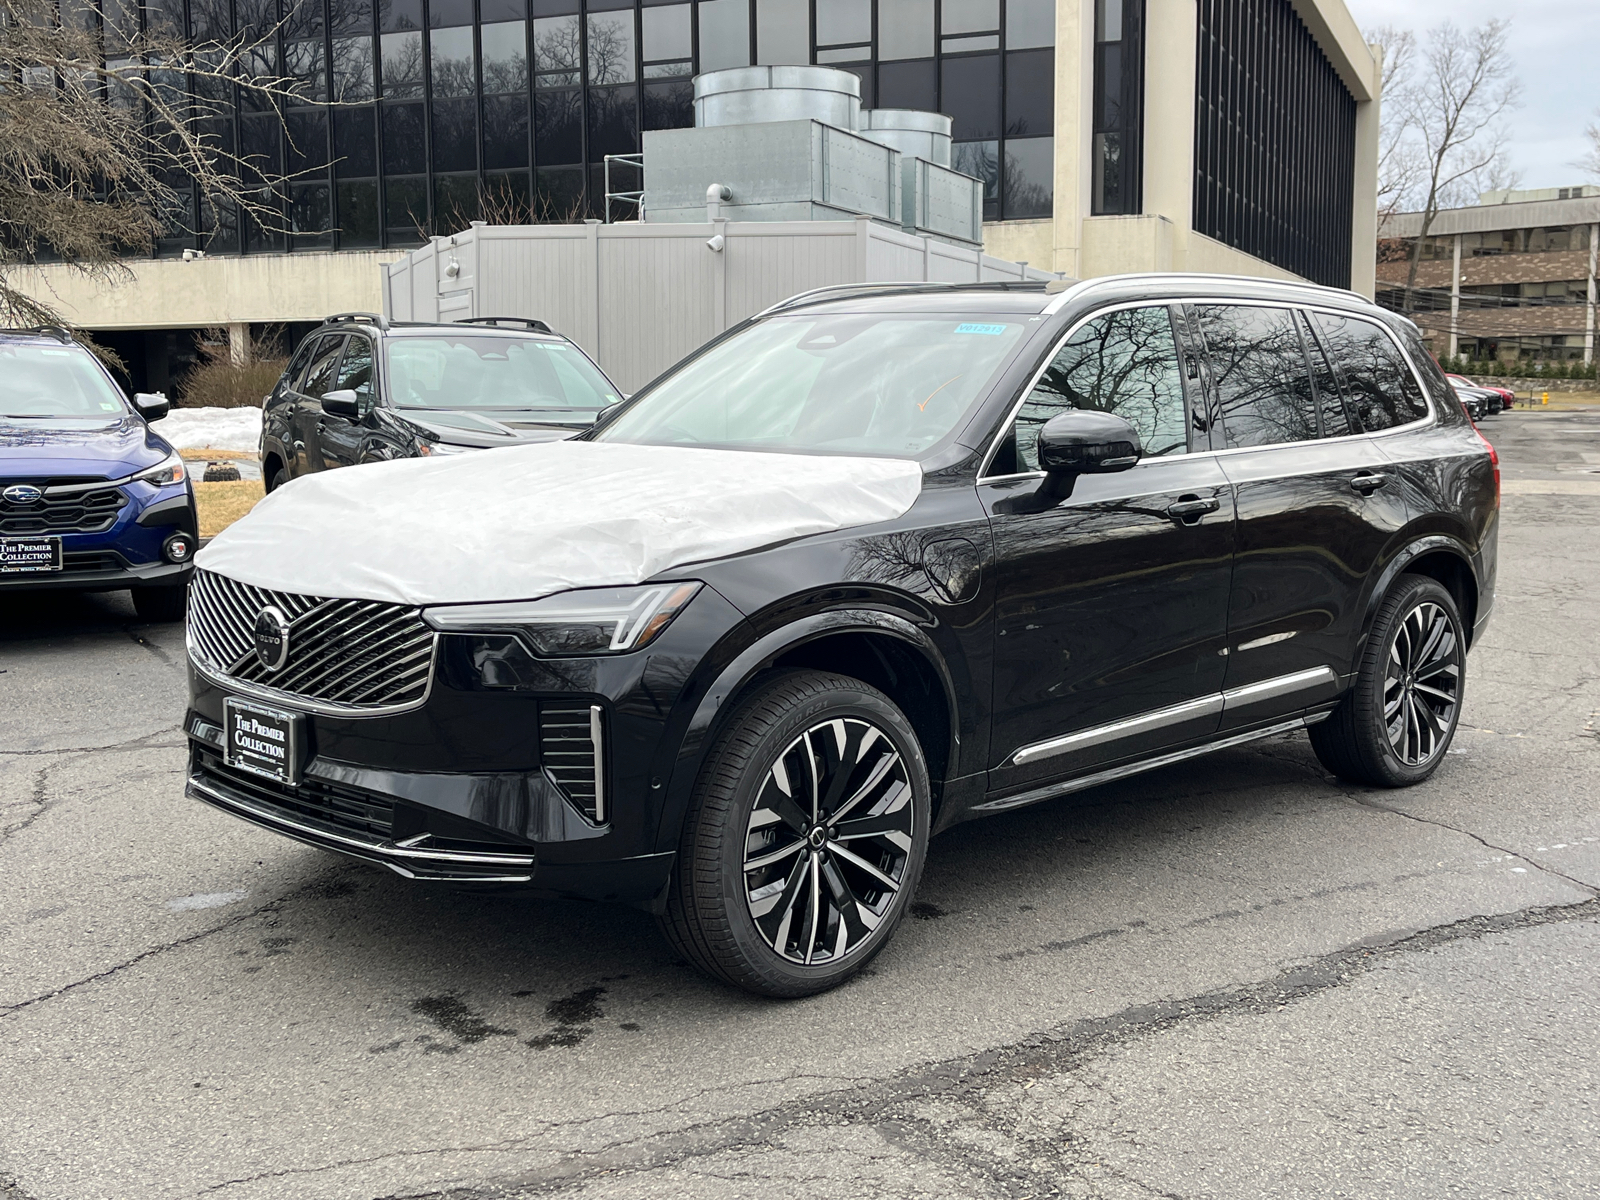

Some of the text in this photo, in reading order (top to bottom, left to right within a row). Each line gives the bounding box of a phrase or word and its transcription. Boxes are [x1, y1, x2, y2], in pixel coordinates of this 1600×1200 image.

[0, 543, 52, 553] THE PREMIER
[0, 552, 52, 561] COLLECTION
[256, 633, 281, 645] VOLVO
[235, 714, 285, 742] THE PREMIER
[235, 730, 285, 759] COLLECTION
